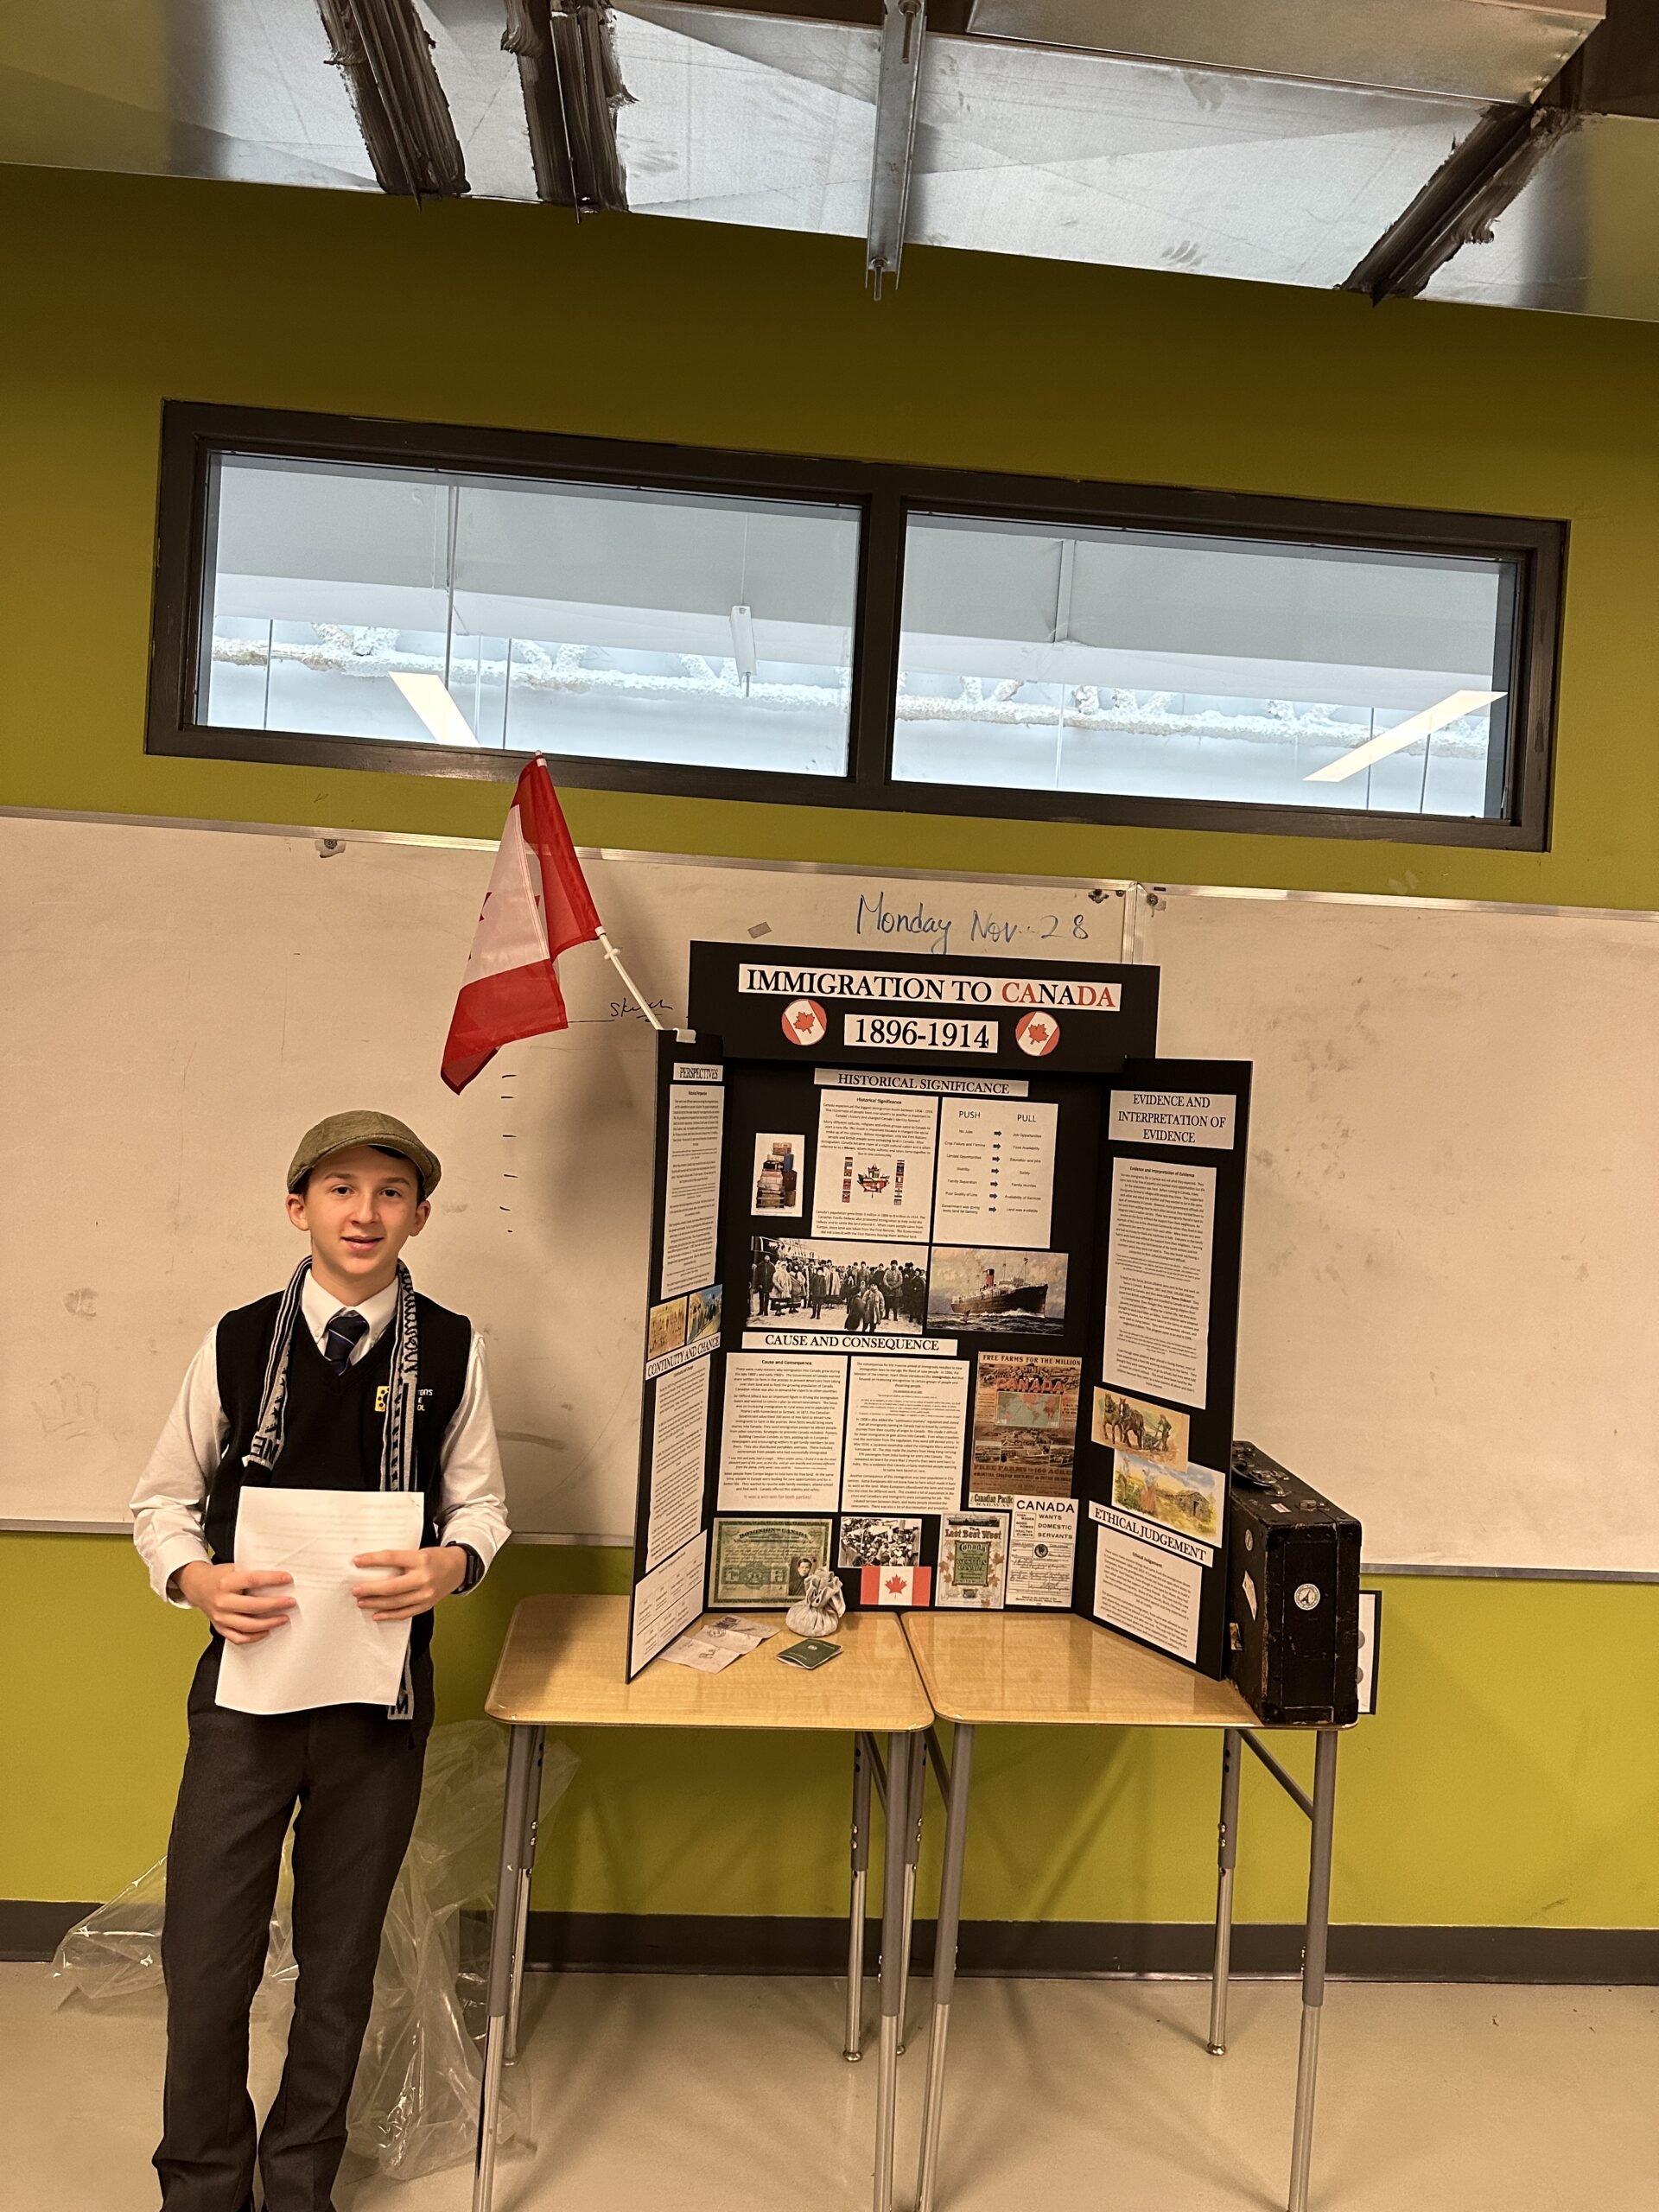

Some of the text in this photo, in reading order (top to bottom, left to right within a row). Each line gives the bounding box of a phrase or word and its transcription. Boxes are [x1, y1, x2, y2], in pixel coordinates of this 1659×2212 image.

[857, 892, 951, 955] Monday
[747, 969, 1116, 1007] IMMIGRATION TO CANADA
[855, 1019, 989, 1049] 1896-1914
[679, 1066, 718, 1079] PERSPECTIVES
[838, 1073, 1009, 1094] HISTORICAL SIGNIFICANCE
[1133, 1093, 1211, 1108] EVIDENCE AND
[959, 1111, 980, 1119] PUSH
[1017, 1114, 1036, 1122] PULL
[1118, 1110, 1226, 1128] INTERPRETATION OF
[1143, 1128, 1196, 1143] EVIDENCE
[765, 1334, 939, 1351] CAUSE AND CONSEQUENCE
[647, 1336, 720, 1377] CONTINUITY AND CHANGE
[996, 1378, 1064, 1392] CANADA
[974, 1494, 1014, 1503] Canadian Pacific
[1016, 1500, 1075, 1513] CANADA
[945, 1529, 1001, 1540] Last Best West
[1094, 1507, 1207, 1561] ETHICAL JUDGEMENT
[959, 1543, 987, 1553] Canada
